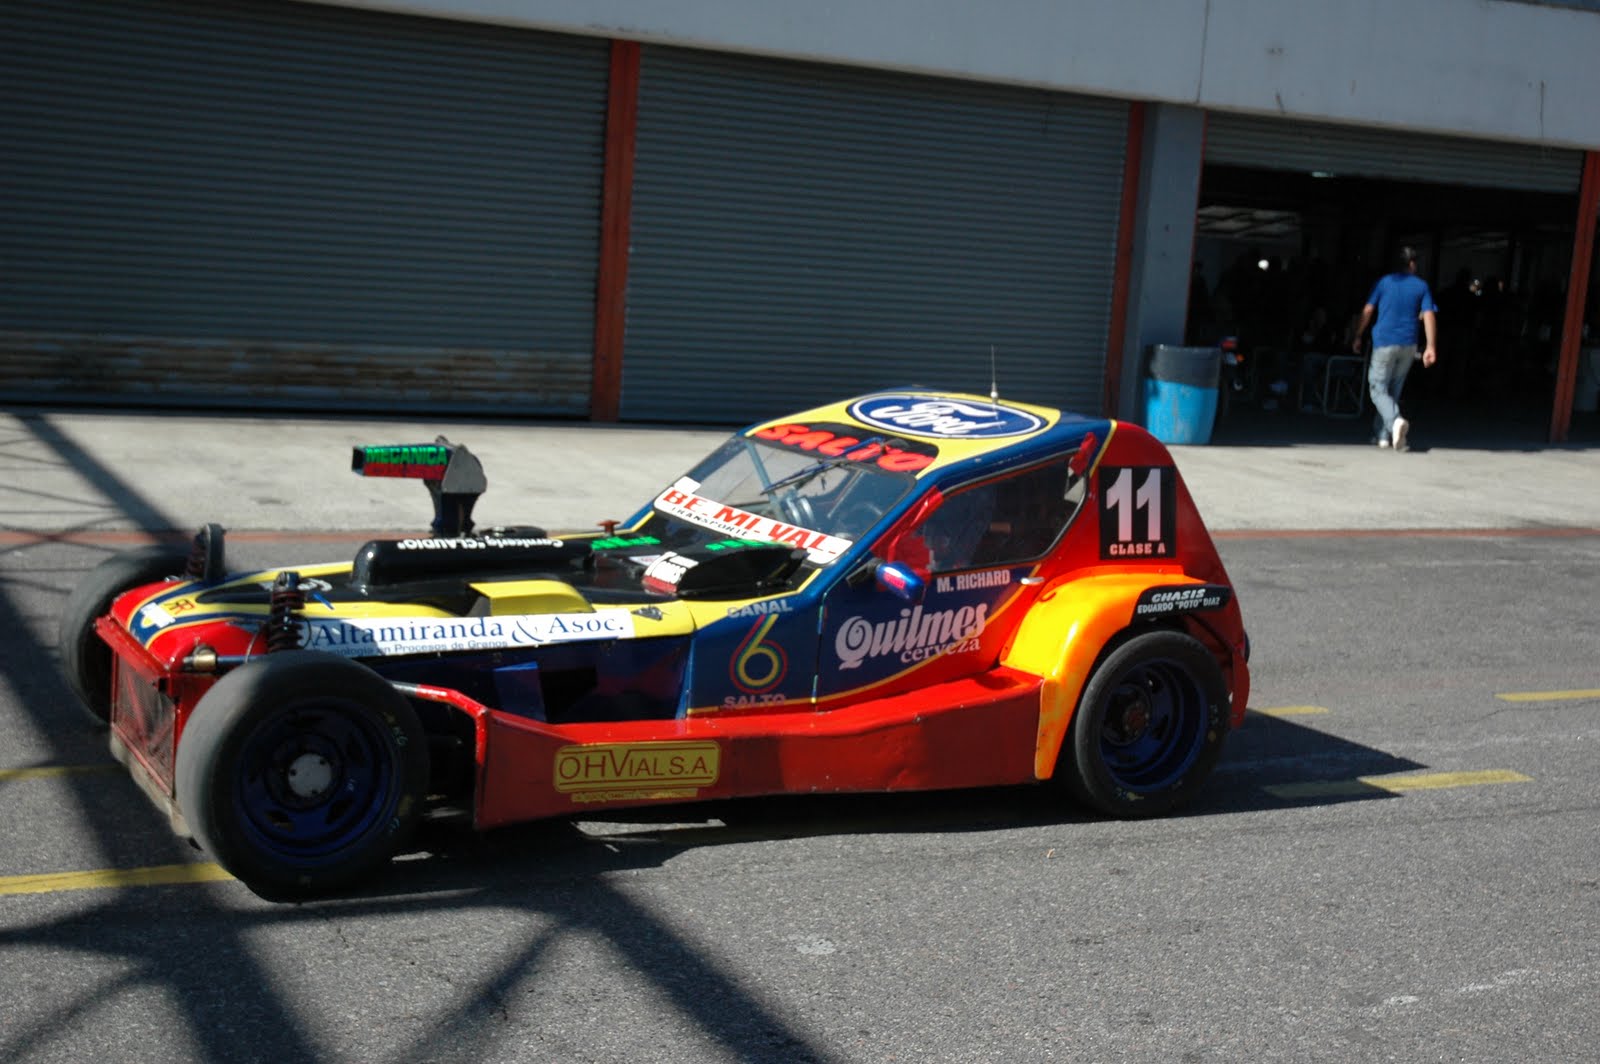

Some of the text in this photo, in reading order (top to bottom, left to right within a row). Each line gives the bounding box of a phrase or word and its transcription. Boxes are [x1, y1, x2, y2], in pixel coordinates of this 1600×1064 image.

[869, 401, 1006, 434] Ford
[1106, 468, 1161, 541] 11
[1109, 542, 1166, 555] CLASE A
[936, 569, 1011, 592] M. RICHARD
[1151, 588, 1206, 603] CHASIS
[727, 598, 793, 618] CANAL
[1137, 602, 1173, 614] EDUARDO
[312, 617, 504, 647] Altamiranda
[834, 602, 989, 671] Quilmes
[394, 642, 448, 654] Procesos
[451, 641, 464, 651] de
[467, 638, 508, 649] Granos
[729, 612, 788, 694] 6
[900, 638, 982, 664] cerveza
[723, 693, 786, 711] SALTO
